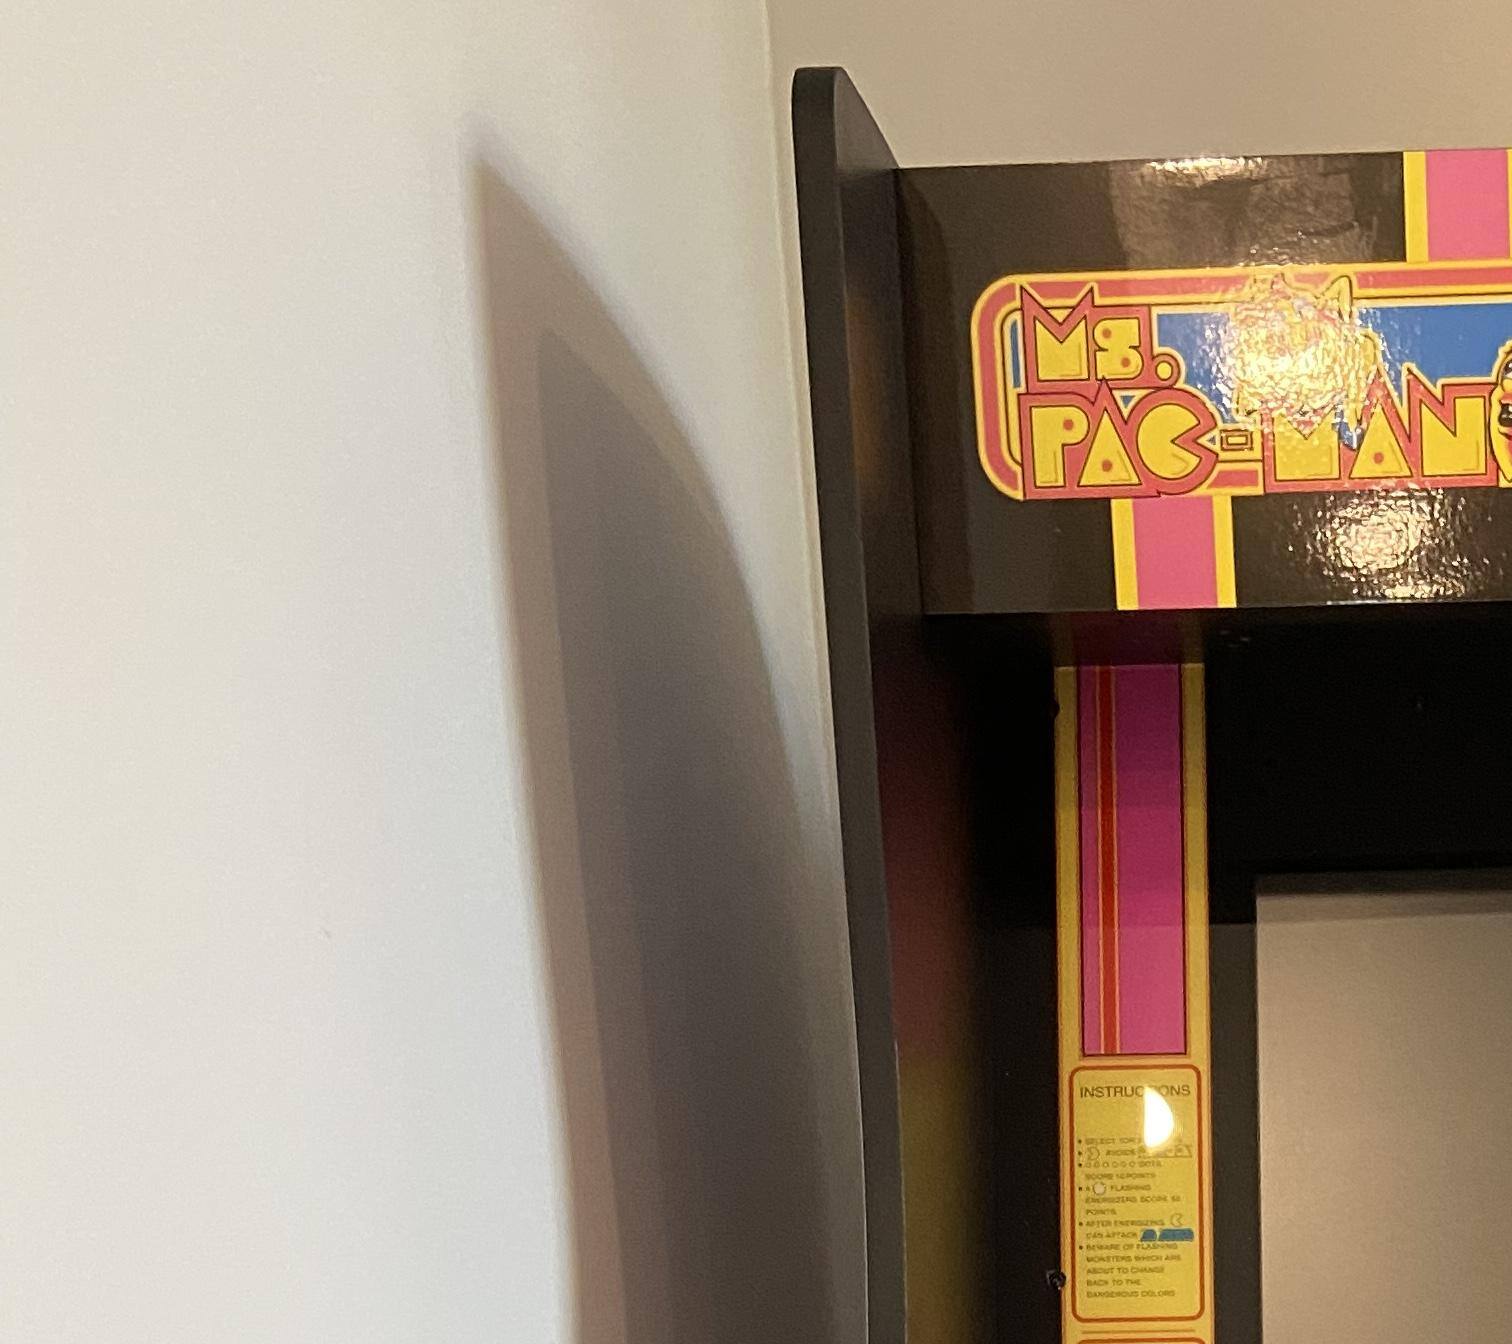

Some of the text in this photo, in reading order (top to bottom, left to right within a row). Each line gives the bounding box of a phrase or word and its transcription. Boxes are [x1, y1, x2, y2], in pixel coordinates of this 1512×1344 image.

[1021, 284, 1178, 385] Ms.
[1022, 370, 1496, 496] PAC-MAN
[1080, 1085, 1191, 1098] INSTRUCONS
